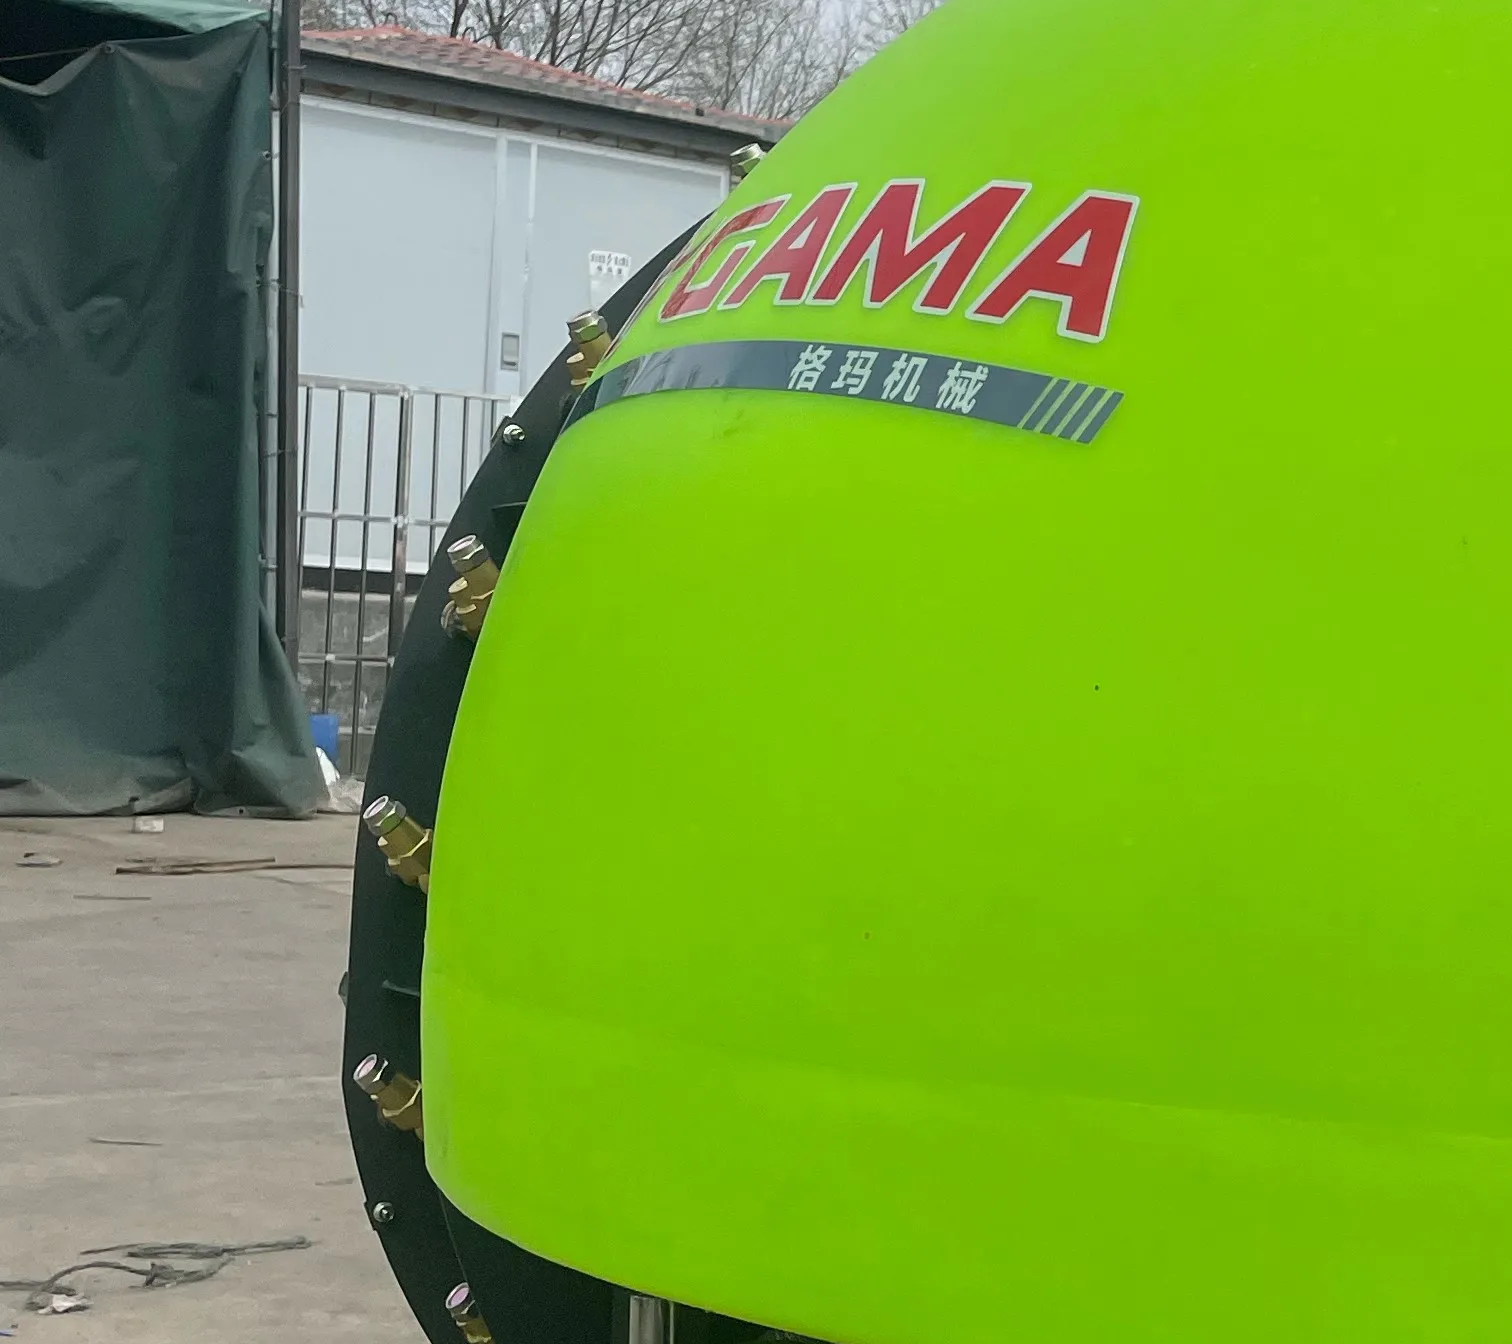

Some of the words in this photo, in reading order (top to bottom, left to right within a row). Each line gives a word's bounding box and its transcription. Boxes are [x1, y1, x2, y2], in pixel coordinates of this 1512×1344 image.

[659, 178, 1139, 342] GAMA
[788, 344, 989, 414] 格玛机械
